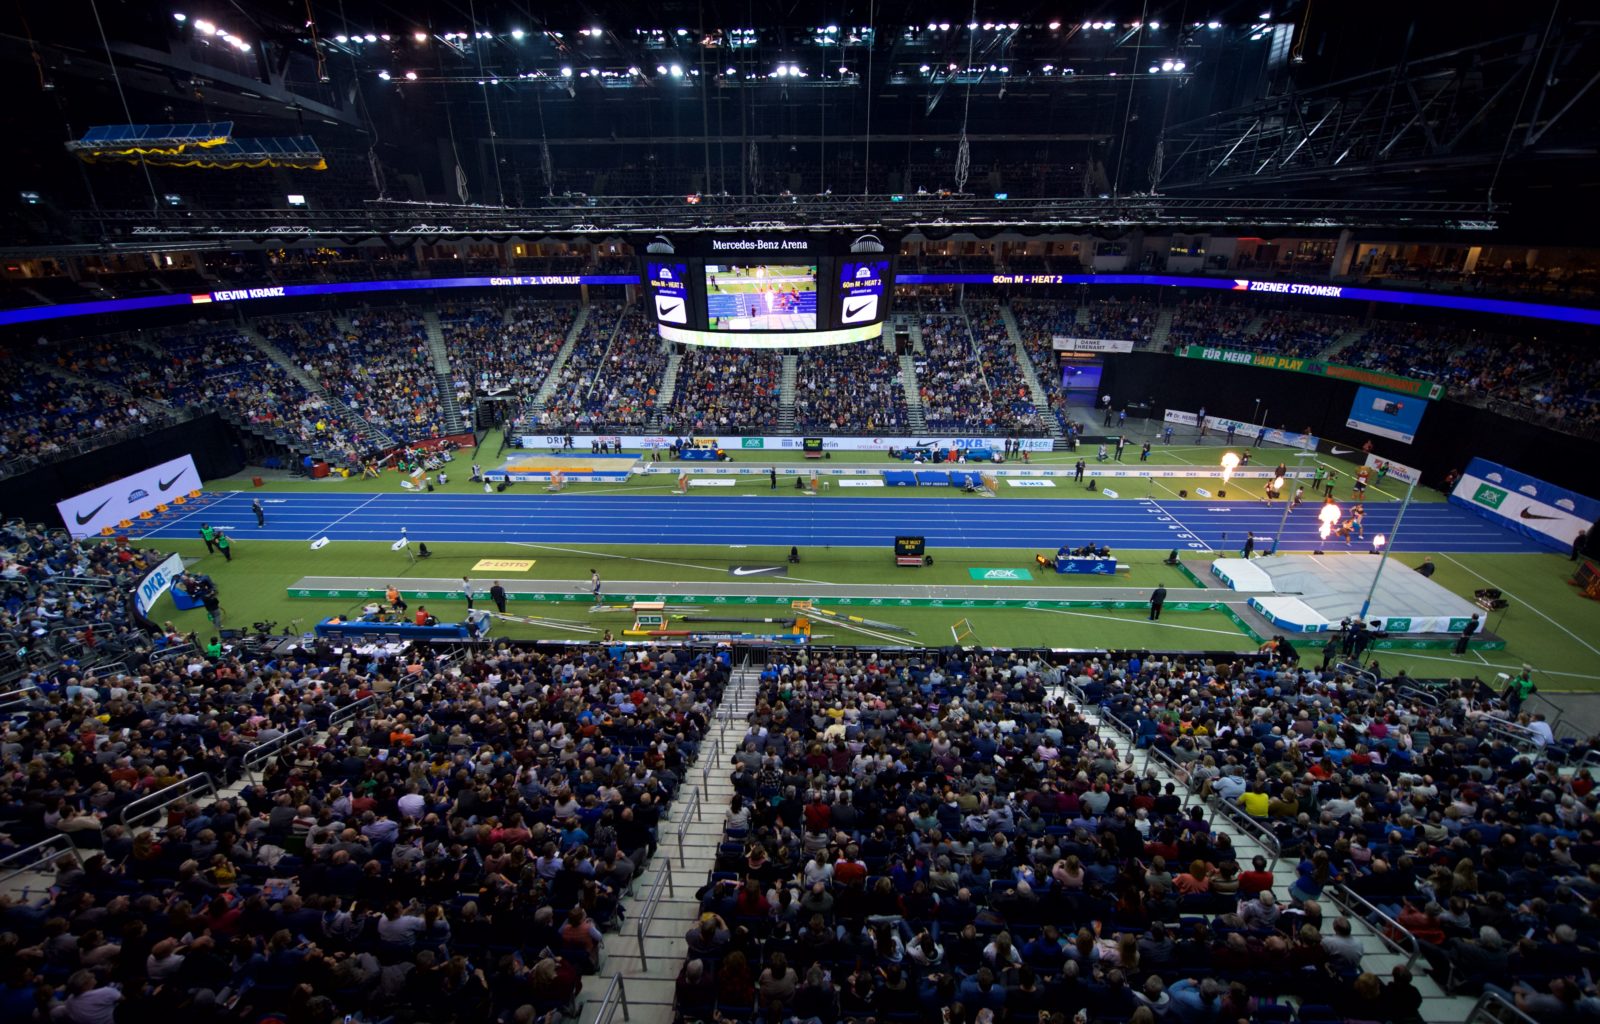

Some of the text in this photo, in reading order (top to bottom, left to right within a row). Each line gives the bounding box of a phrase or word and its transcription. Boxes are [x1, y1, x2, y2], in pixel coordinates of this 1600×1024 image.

[713, 240, 807, 249] Mercedes-Benz Arena
[490, 278, 511, 286] 60m
[513, 277, 522, 285] M
[541, 276, 580, 284] VORLAUF
[992, 276, 1012, 284] 60m
[1014, 276, 1024, 284] M
[1031, 276, 1056, 284] HEAT
[1056, 276, 1063, 284] 2
[1250, 281, 1290, 293] ZDENEK
[214, 286, 286, 302] KEVIN KRANZ
[1202, 348, 1222, 360] FÜR
[1223, 352, 1252, 364] MEHR
[1278, 358, 1304, 370] PLAY
[546, 436, 575, 444] DRIE
[956, 438, 983, 448] DKB
[984, 570, 1019, 578] AOK
[143, 572, 166, 600] DKB
